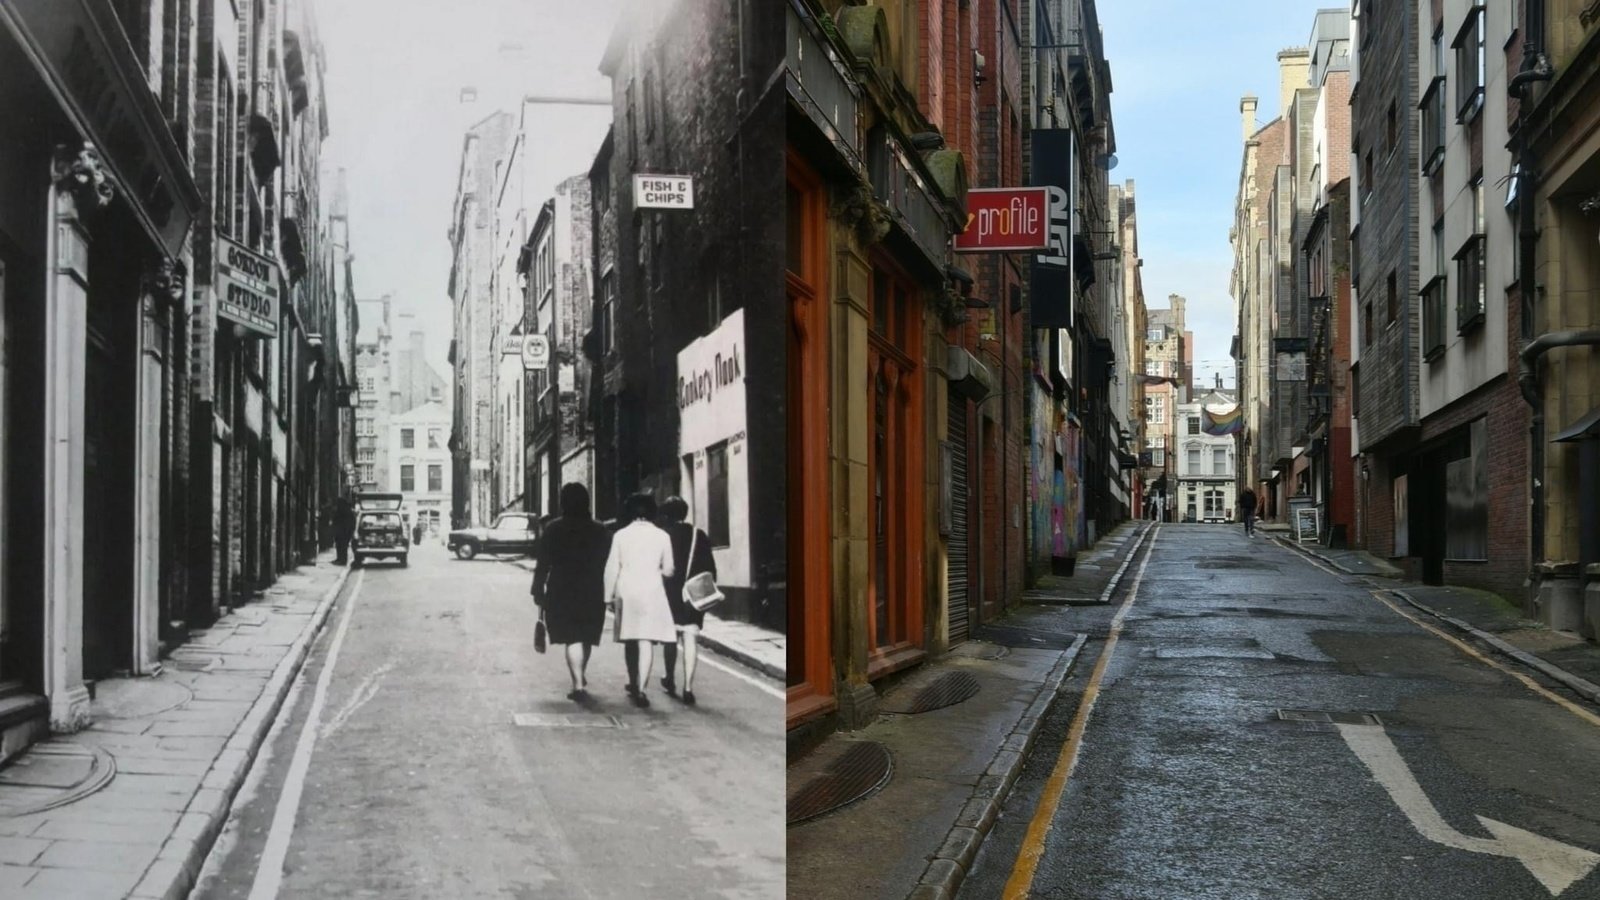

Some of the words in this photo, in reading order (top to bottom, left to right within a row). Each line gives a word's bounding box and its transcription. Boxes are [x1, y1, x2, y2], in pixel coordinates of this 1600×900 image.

[642, 180, 672, 191] FISH
[678, 181, 687, 192] &
[645, 193, 684, 203] CHIPS
[978, 196, 1038, 245] profile
[227, 283, 271, 317] STUDIO
